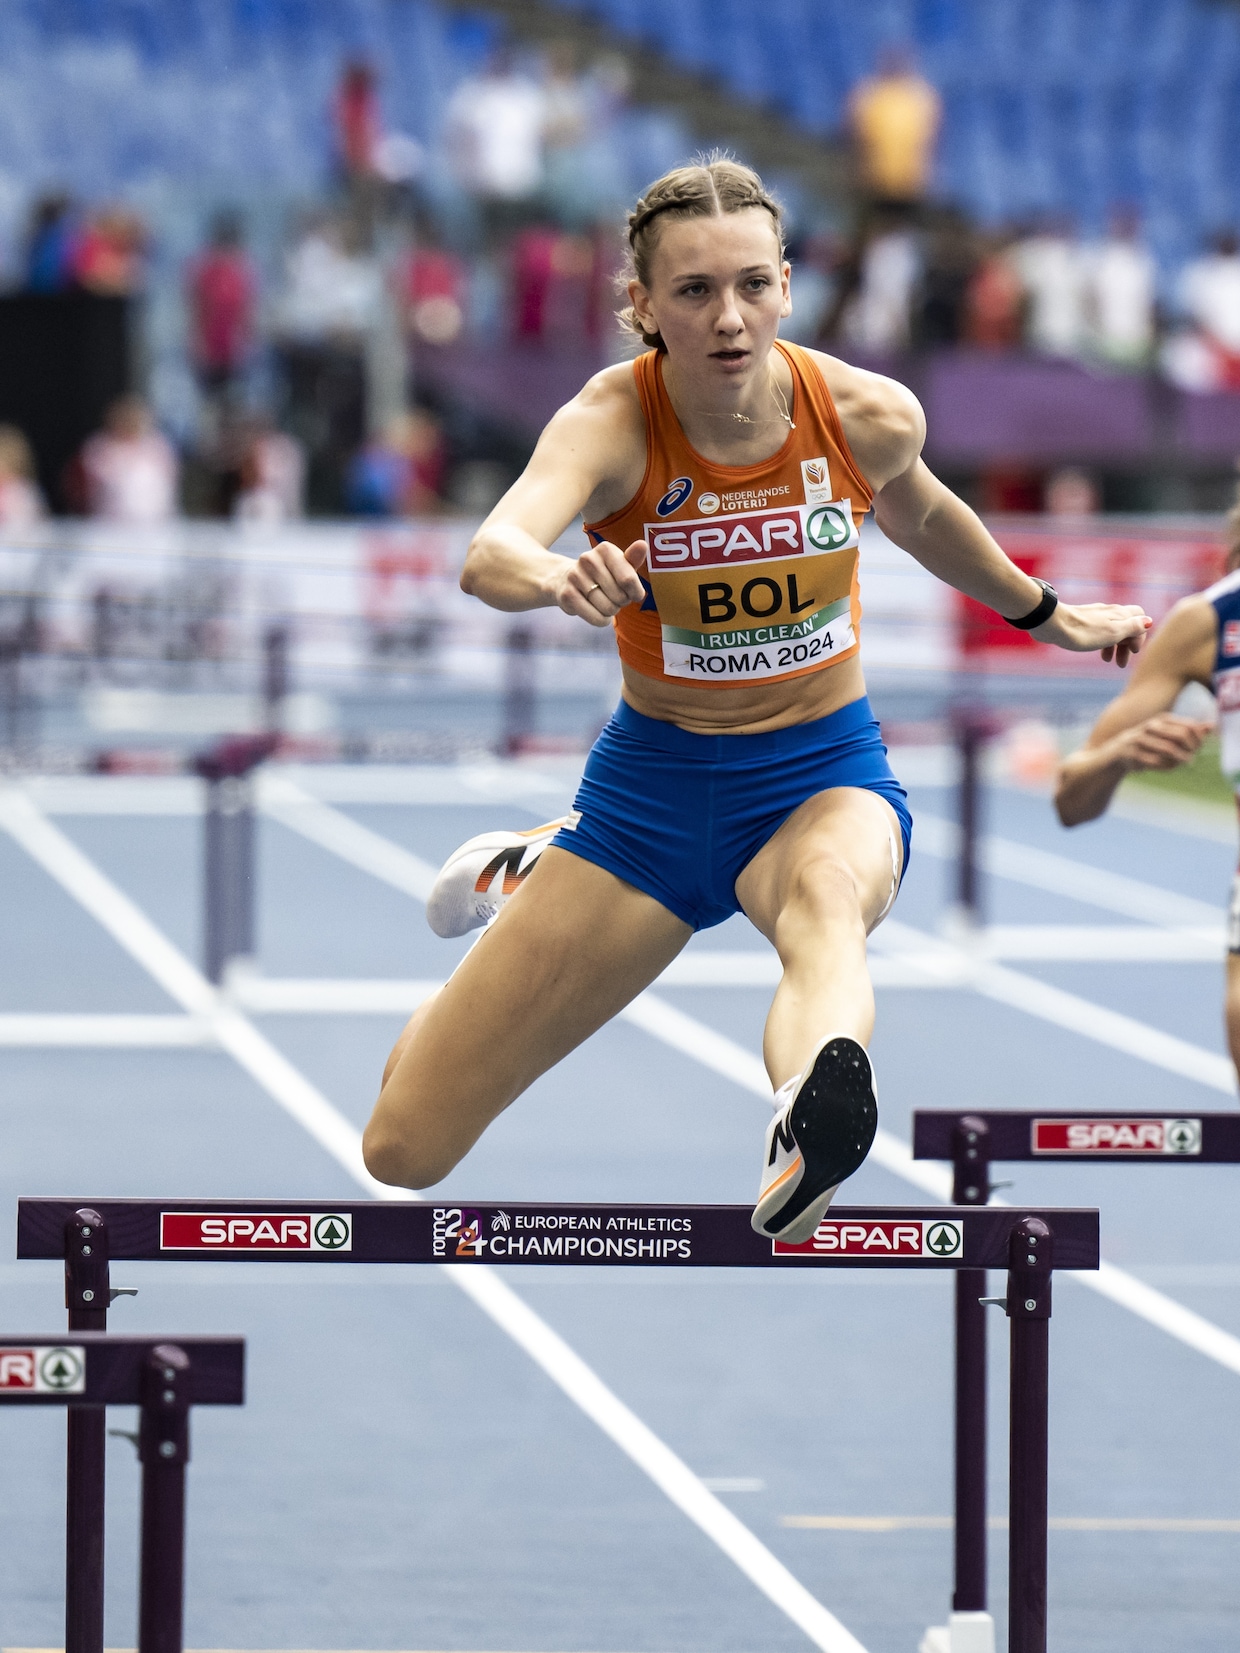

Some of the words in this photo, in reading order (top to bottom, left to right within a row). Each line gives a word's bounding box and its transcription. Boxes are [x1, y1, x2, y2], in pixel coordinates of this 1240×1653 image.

[721, 485, 791, 501] NEDERLANDSE
[722, 498, 767, 511] LOTERIJ
[653, 518, 799, 563] SPAR
[698, 573, 815, 624] BOL
[700, 634, 706, 648] I
[709, 629, 750, 648] RUN
[689, 652, 771, 673] ROMA
[777, 631, 834, 666] 2024
[1067, 1124, 1163, 1148] SPAR
[200, 1219, 308, 1244] SPAR
[432, 1208, 446, 1256] roma
[514, 1215, 601, 1230] EUROPEAN
[606, 1216, 692, 1232] ATHLETICS
[489, 1235, 692, 1259] CHAMPIONSHIPS
[812, 1226, 920, 1250] SPAR
